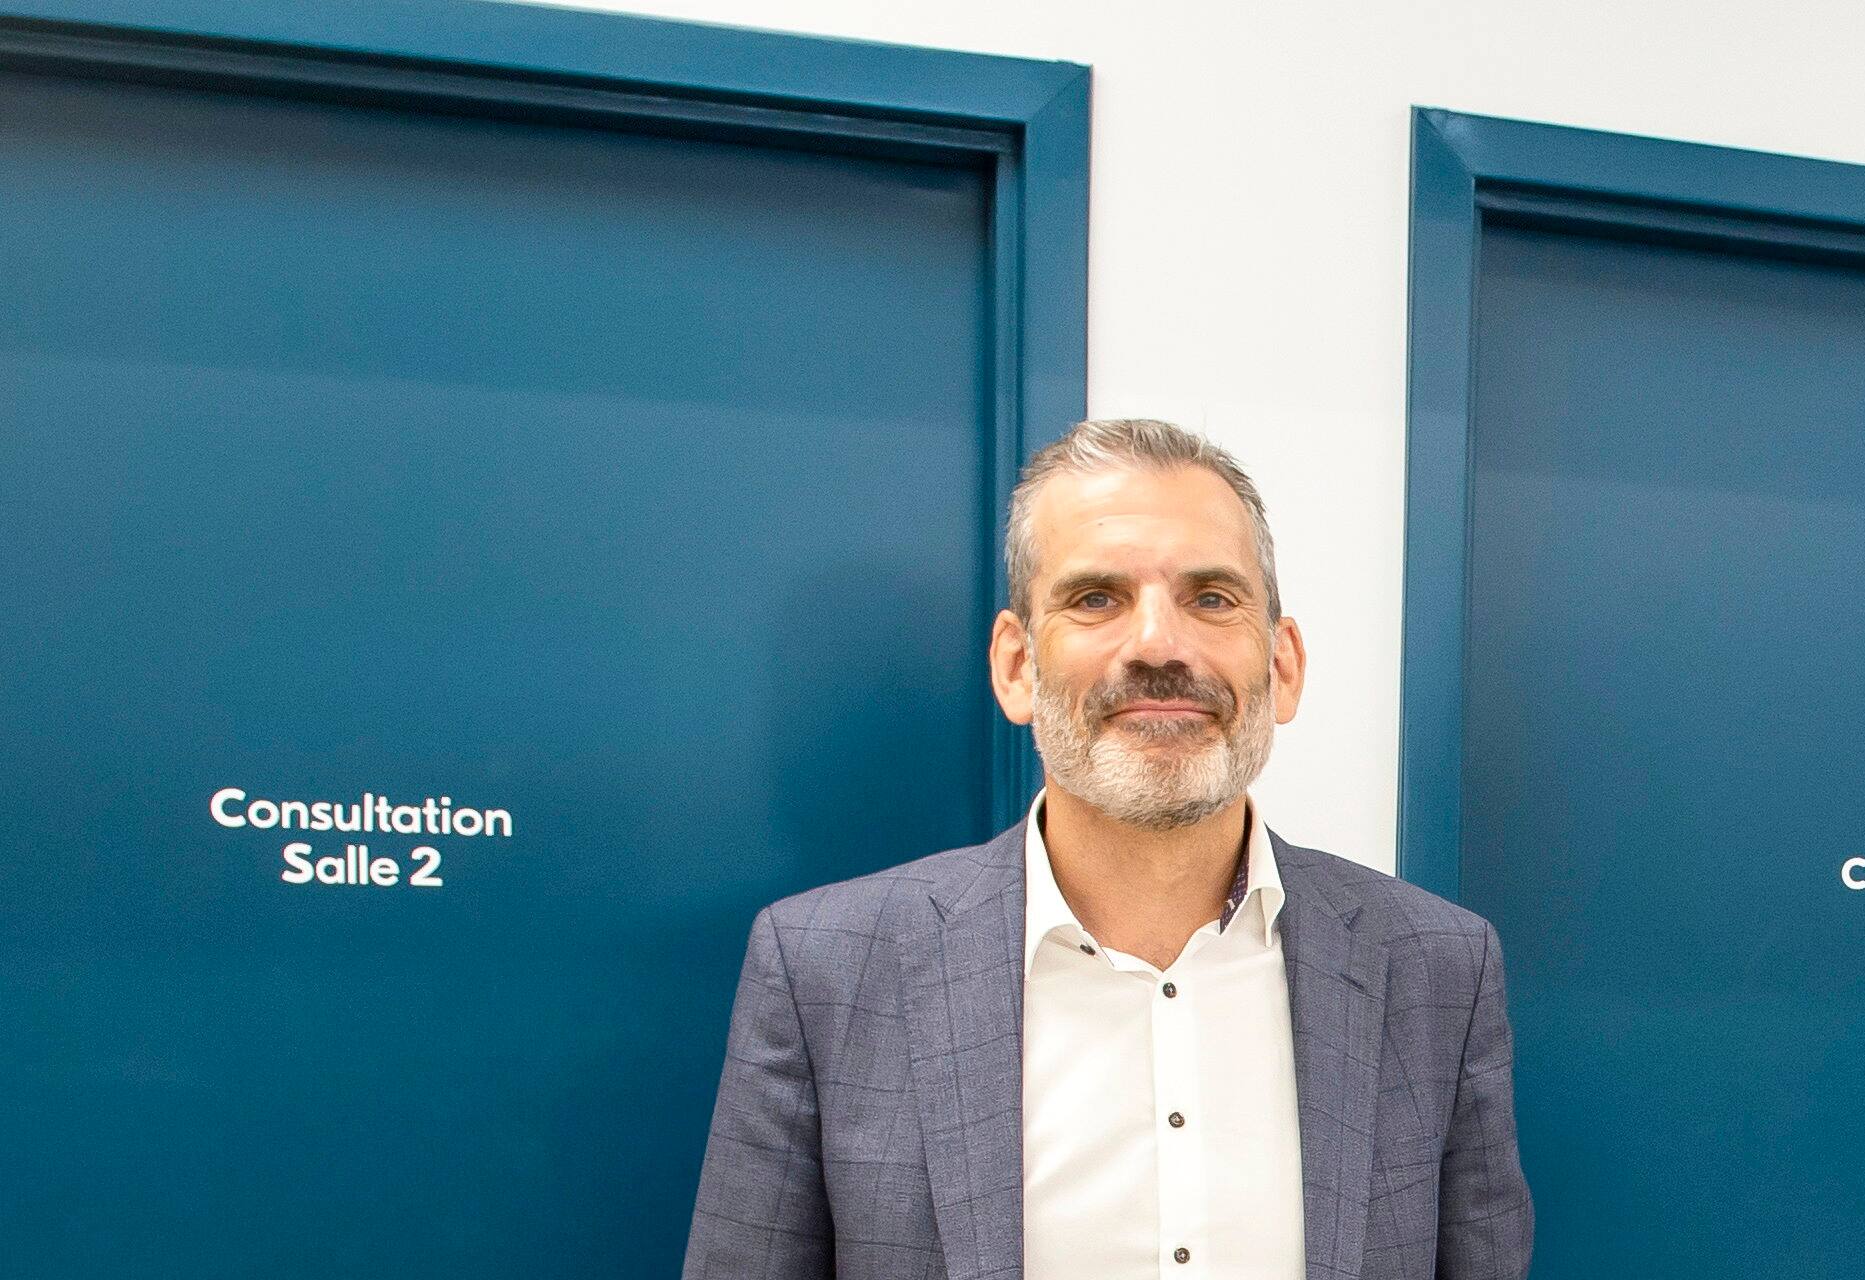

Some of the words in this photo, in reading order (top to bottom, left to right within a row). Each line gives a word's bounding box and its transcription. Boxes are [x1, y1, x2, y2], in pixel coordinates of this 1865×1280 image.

[209, 787, 513, 837] Consultation
[281, 842, 400, 887] Salle
[409, 845, 443, 887] 2
